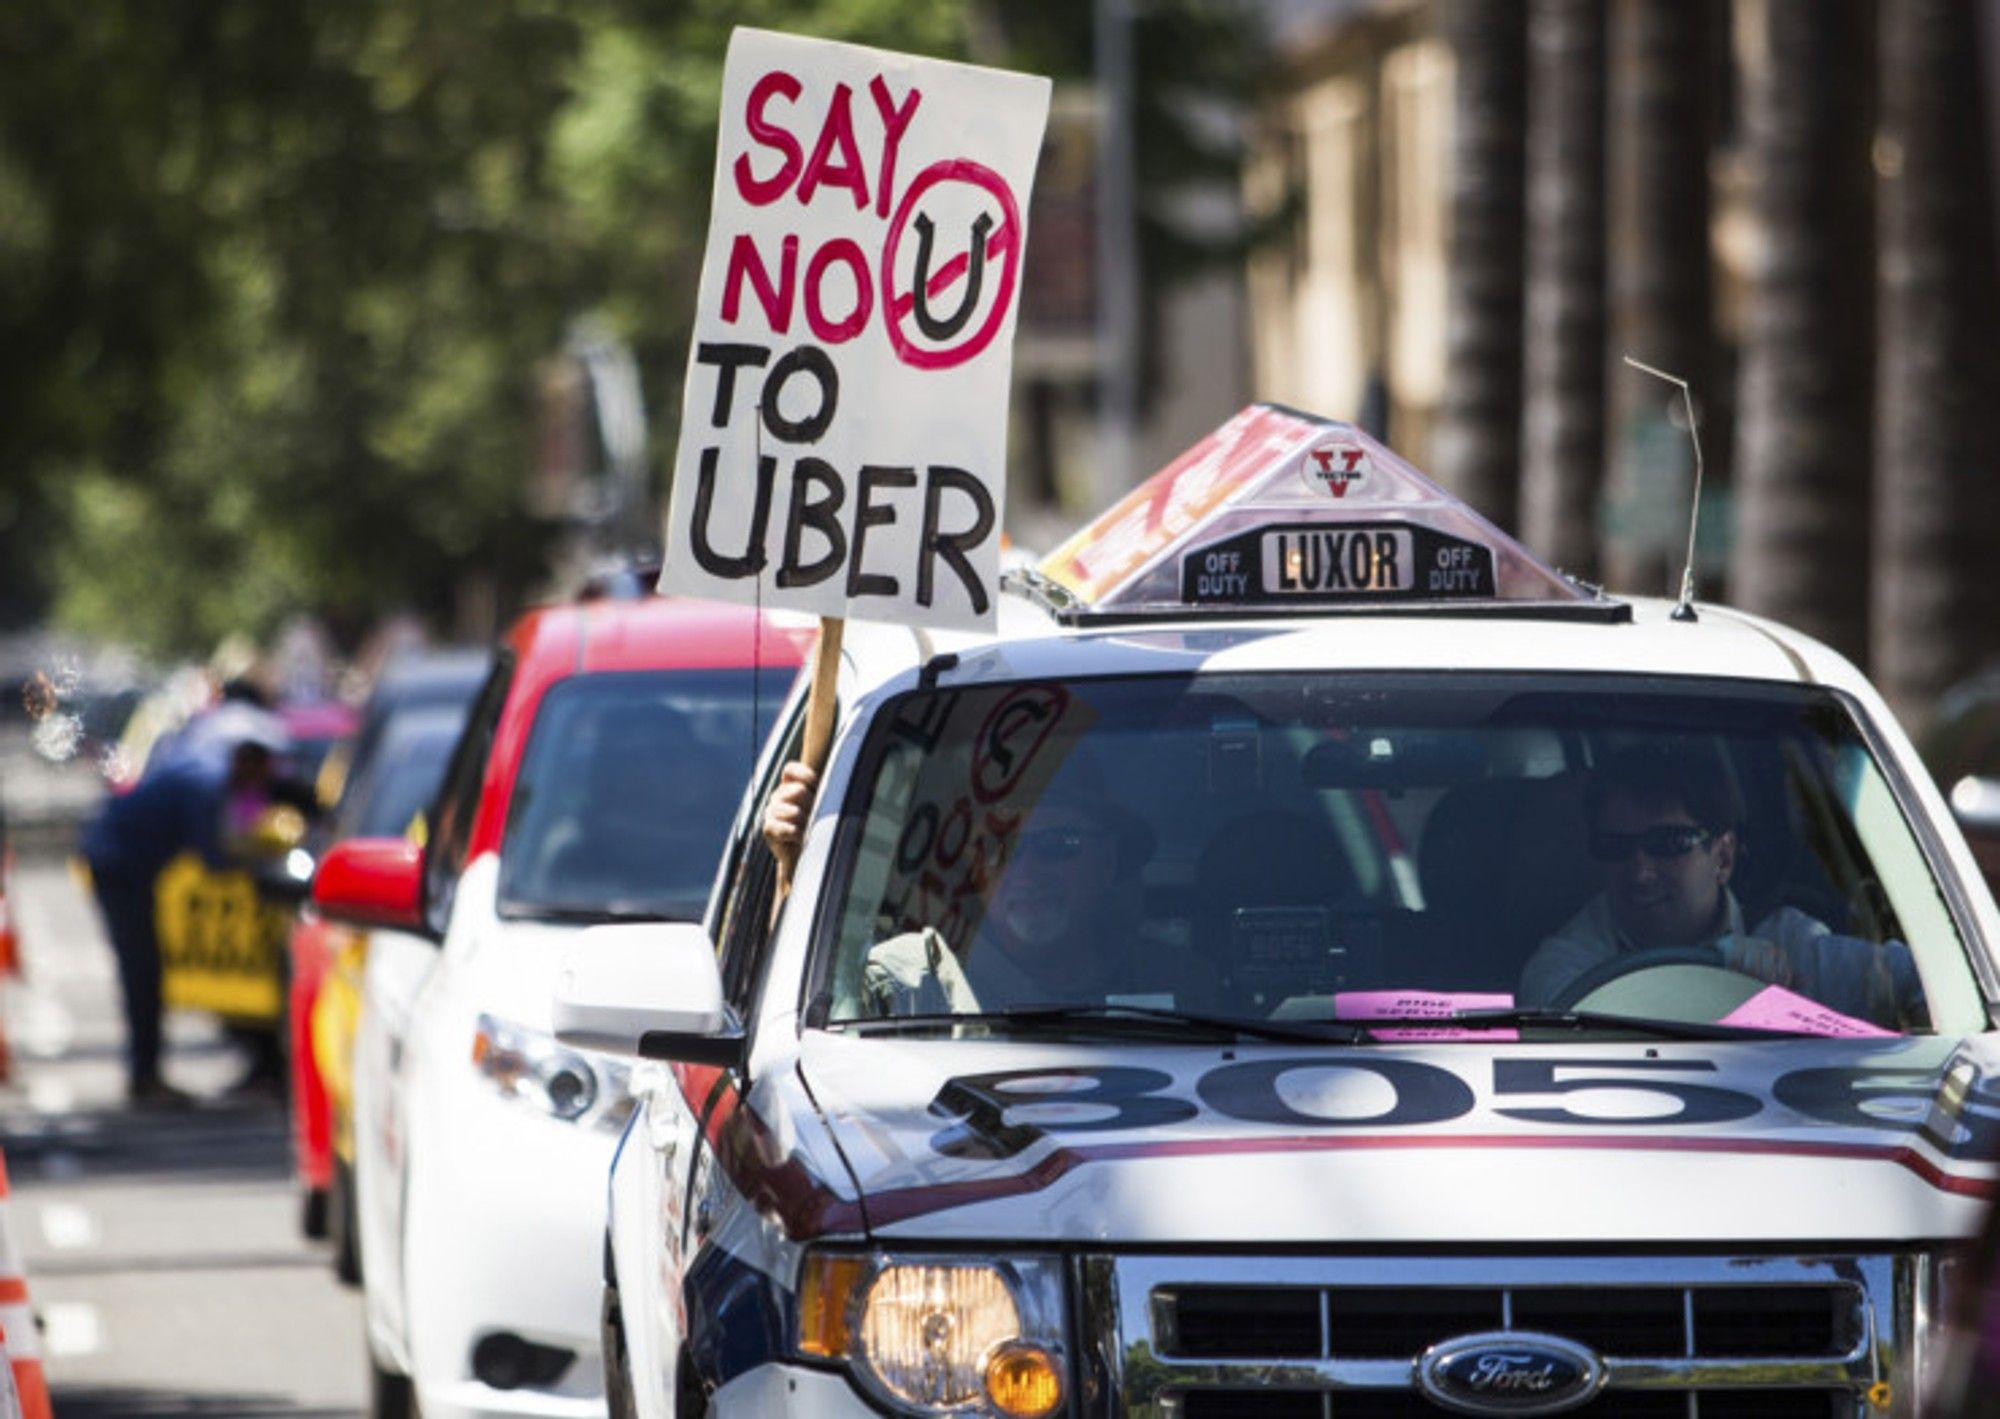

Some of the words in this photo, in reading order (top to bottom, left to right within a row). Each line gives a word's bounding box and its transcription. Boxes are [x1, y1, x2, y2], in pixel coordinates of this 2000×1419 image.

[734, 71, 922, 219] SAY
[721, 234, 874, 344] NO
[697, 343, 839, 444] TO
[690, 447, 996, 617] UBER
[1204, 552, 1241, 574] OFF
[1277, 531, 1400, 591] LUXOR
[1429, 568, 1481, 591] DUTY
[1436, 546, 1472, 568] OFF
[1197, 573, 1248, 596] DUTY
[1469, 1354, 1554, 1391] Ford
